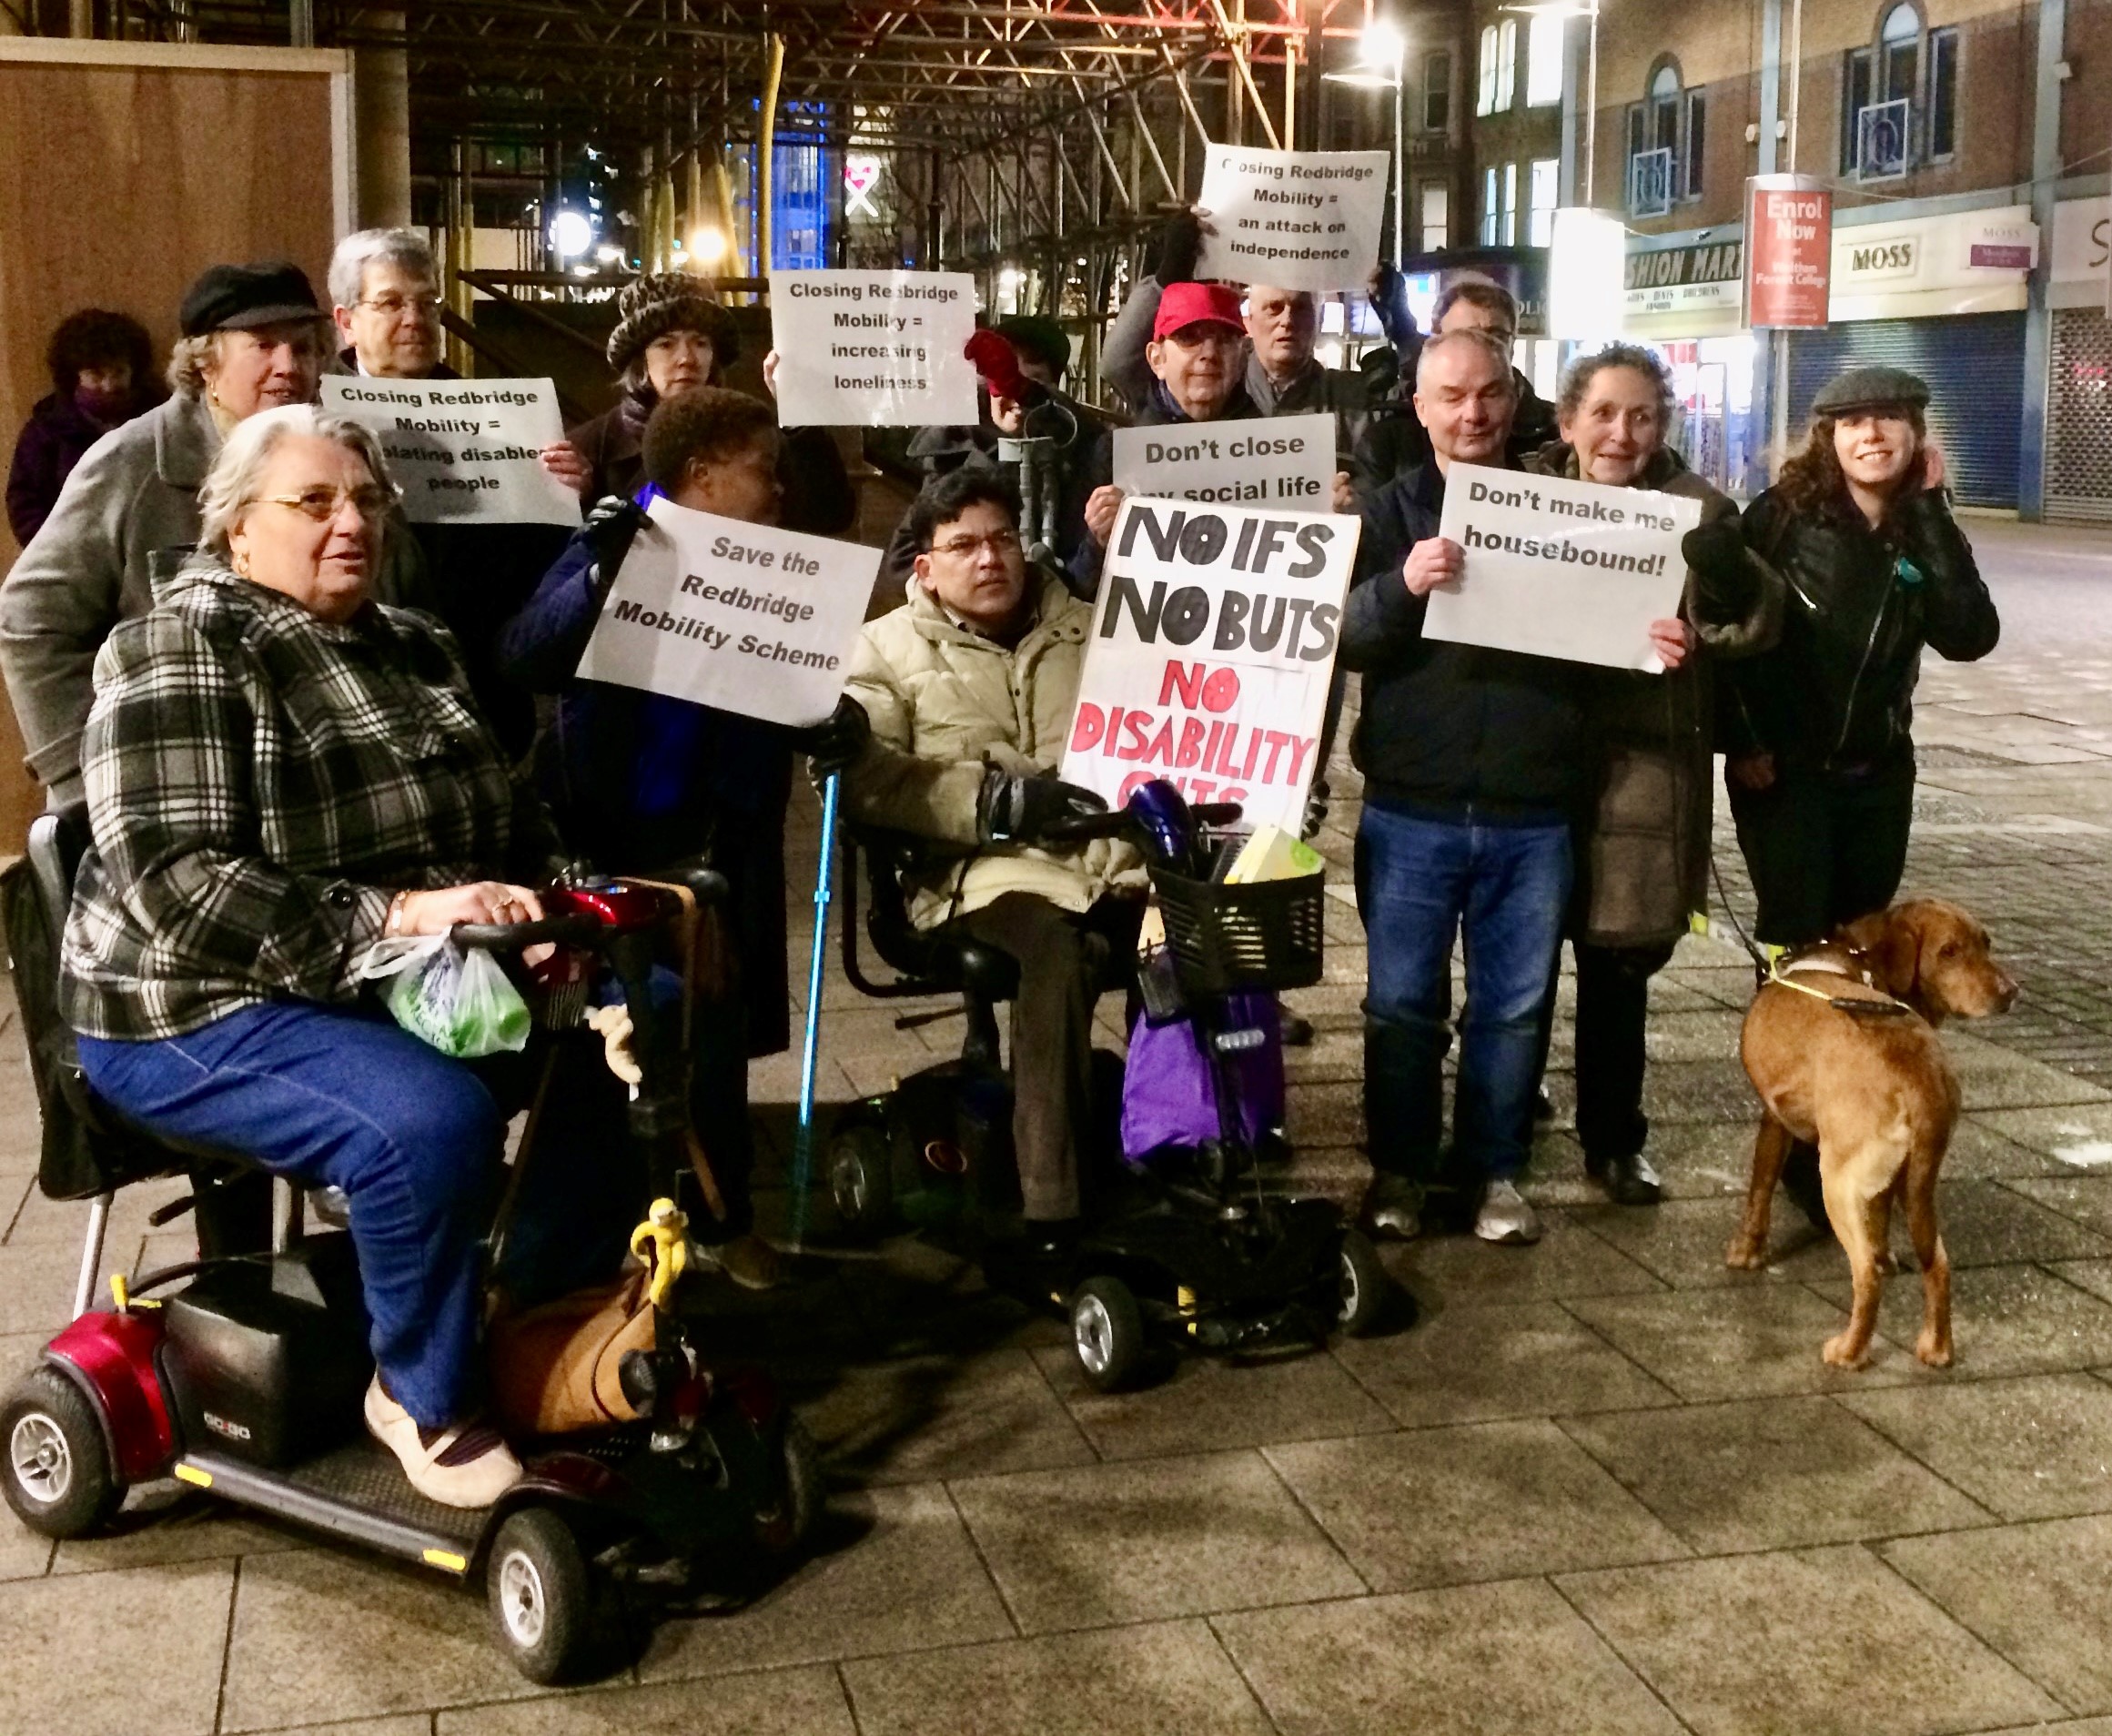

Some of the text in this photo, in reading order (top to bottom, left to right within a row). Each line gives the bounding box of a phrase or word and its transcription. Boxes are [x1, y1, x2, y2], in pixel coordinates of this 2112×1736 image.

[1222, 158, 1373, 181] Cosing Redbridge
[1254, 188, 1323, 208] Mobility
[1767, 194, 1823, 219] Enrol
[1238, 217, 1346, 234] an attack on
[1776, 219, 1816, 240] Now
[1230, 240, 1349, 260] independence
[1853, 243, 1911, 271] MOSS
[1624, 250, 1685, 289] SHION
[790, 283, 862, 301] Closing
[834, 375, 926, 389] loneliness
[341, 389, 538, 408] Closing Redbridge
[396, 417, 480, 436] Mobility
[1146, 437, 1305, 464] Don't close
[428, 475, 500, 494] people
[1184, 476, 1321, 502] social life
[1470, 481, 1675, 532] Don't make me
[1117, 505, 1336, 579] NO IFS
[1464, 524, 1667, 576] housebound!
[711, 537, 820, 576] Save the
[681, 573, 813, 623] Redbridge
[1099, 575, 1340, 662] NO BUTS
[614, 600, 840, 671] Mobility Scheme
[1157, 659, 1241, 713] NO
[1071, 701, 1316, 787] DISABILITY
